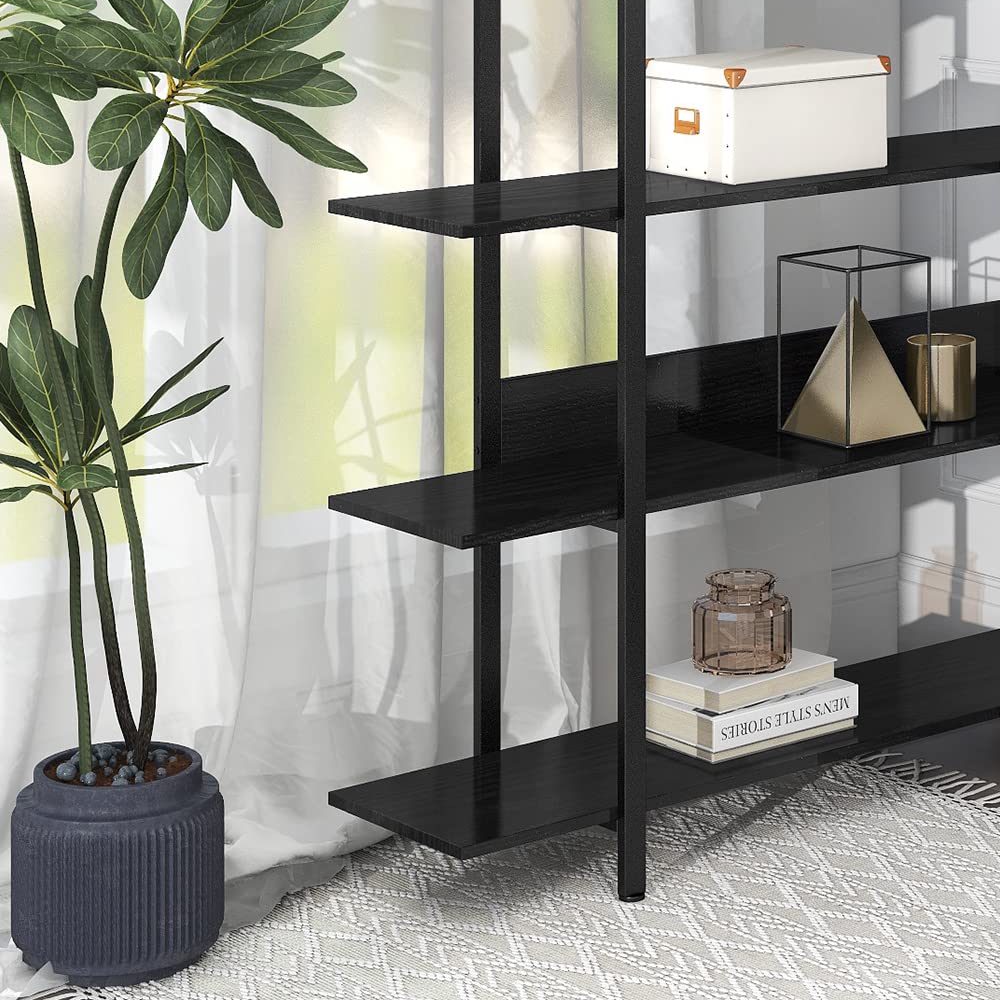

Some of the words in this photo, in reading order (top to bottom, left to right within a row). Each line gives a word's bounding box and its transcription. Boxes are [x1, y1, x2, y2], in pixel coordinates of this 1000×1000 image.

[774, 705, 812, 728] STYLE
[814, 696, 850, 717] MEN'S
[721, 715, 773, 741] STORIES
